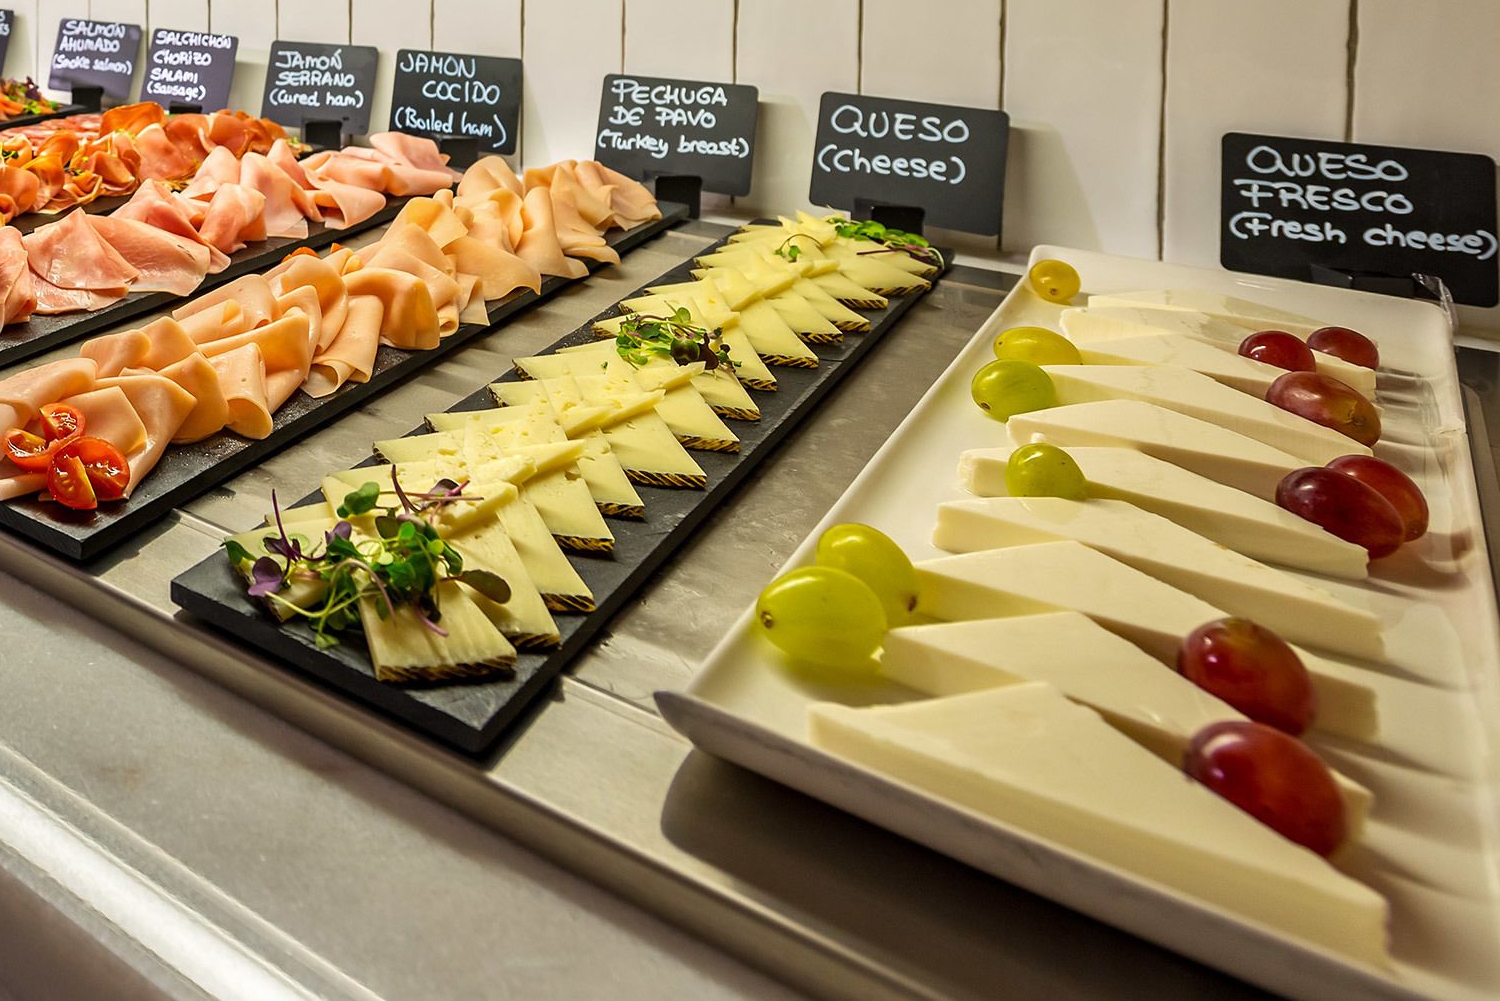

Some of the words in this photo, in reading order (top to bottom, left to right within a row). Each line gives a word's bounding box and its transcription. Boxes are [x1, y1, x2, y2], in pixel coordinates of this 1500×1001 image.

[59, 35, 120, 52] AHUMADO
[149, 67, 198, 84] SALAMI
[275, 70, 355, 87] SERRANO
[326, 90, 364, 108] ham)
[422, 80, 500, 105] COCIDO
[611, 79, 728, 107] PECHUGA
[395, 106, 454, 133] (Boiled
[461, 111, 506, 148] ham)
[608, 105, 645, 126] DE
[655, 106, 716, 128] PAVO
[830, 104, 970, 144] QUESO
[598, 128, 669, 159] (Turkey
[677, 134, 750, 158] breast)
[817, 143, 967, 185] (Cheese)
[1246, 145, 1409, 181] QUESO
[1233, 178, 1414, 215] FRESCO
[1228, 211, 1348, 245] (Fresh
[1362, 222, 1499, 261] cheese)
